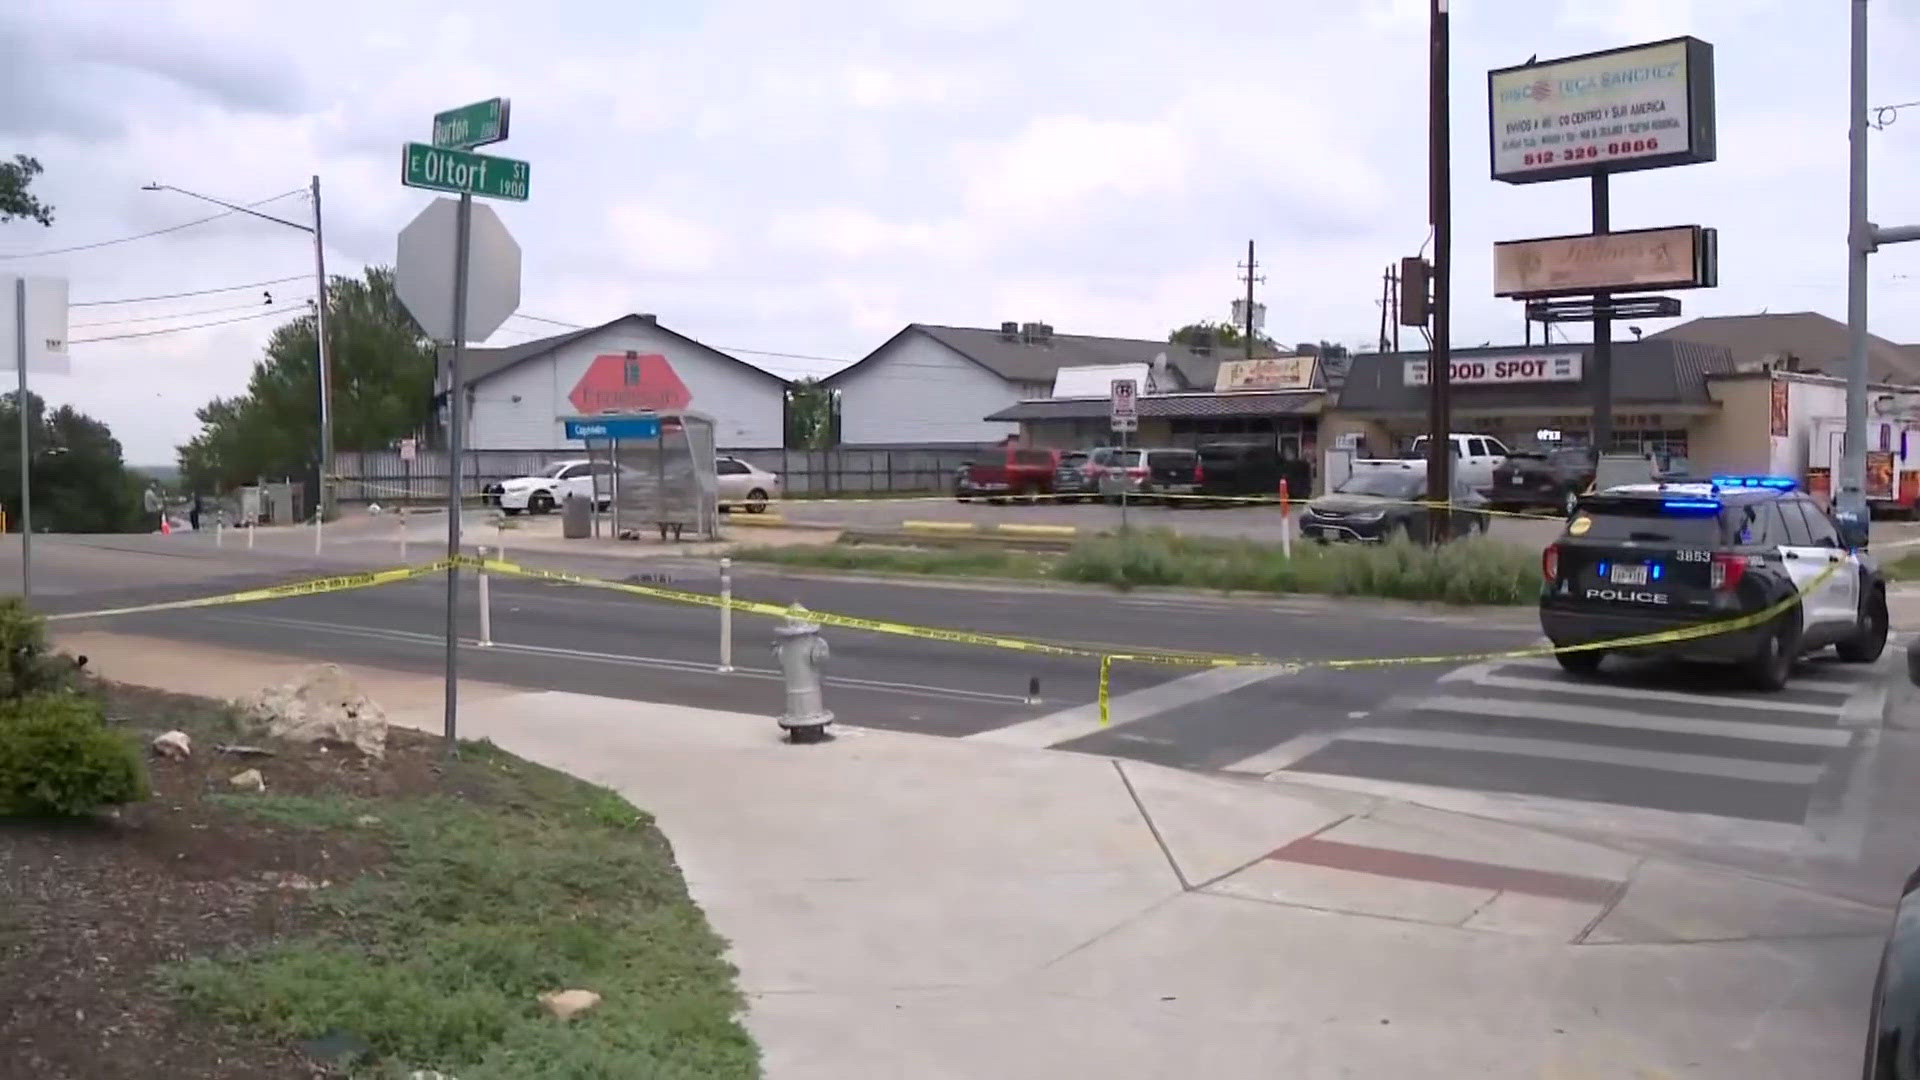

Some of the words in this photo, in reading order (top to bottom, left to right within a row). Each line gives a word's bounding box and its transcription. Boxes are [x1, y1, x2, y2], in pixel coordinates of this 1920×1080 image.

[1571, 109, 1601, 125] CENTRO
[1630, 99, 1665, 115] AMERICA
[411, 156, 420, 172] E
[425, 151, 487, 190] Oltorf
[513, 162, 525, 179] ST
[500, 179, 525, 197] 1900
[1450, 362, 1484, 380] OOD
[1494, 359, 1547, 379] SPOT
[1676, 550, 1711, 563] 3853
[1586, 588, 1669, 605] POLICE
